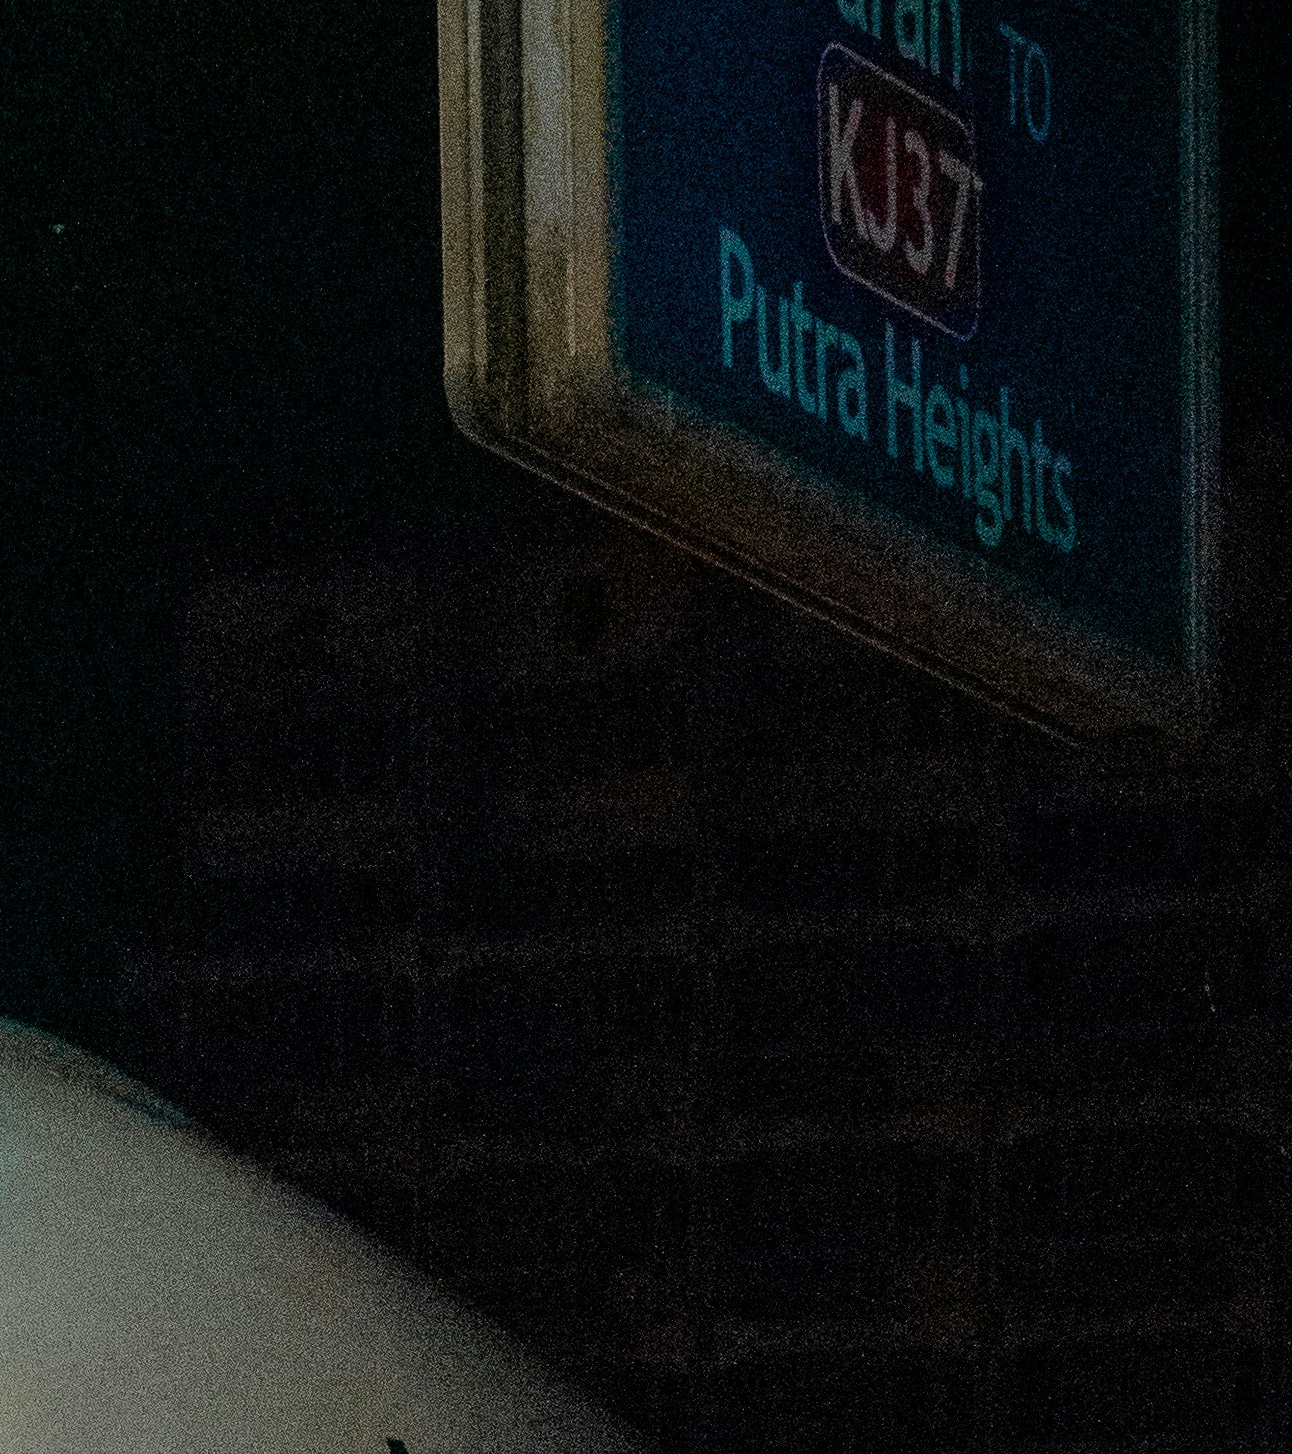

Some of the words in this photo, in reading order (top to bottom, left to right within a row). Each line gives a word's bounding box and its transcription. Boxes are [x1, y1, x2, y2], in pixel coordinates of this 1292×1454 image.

[828, 82, 985, 289] KJ37
[718, 226, 870, 443] Putra
[885, 319, 1078, 555] Heights
